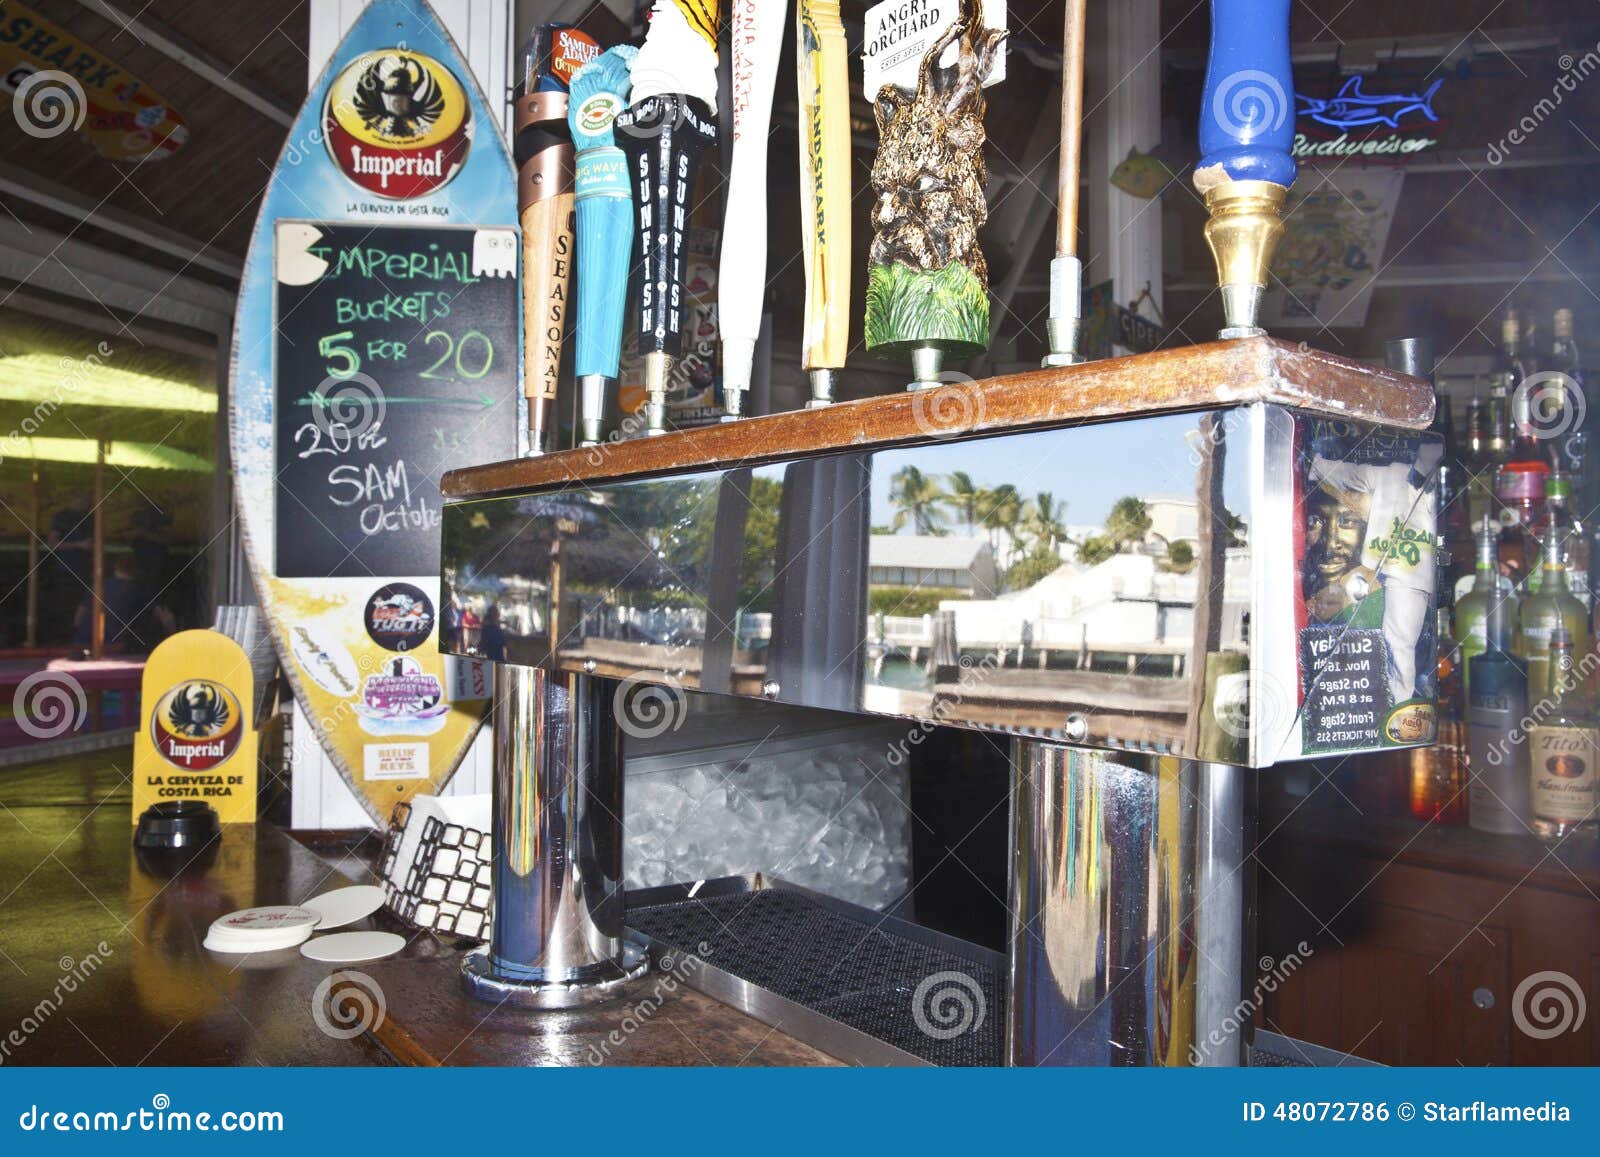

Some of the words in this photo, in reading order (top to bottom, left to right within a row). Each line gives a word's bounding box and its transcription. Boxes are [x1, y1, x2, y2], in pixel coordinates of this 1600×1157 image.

[869, 8, 940, 57] ORCHARD
[879, 0, 929, 34] ANGRY
[0, 8, 118, 90] SHARK
[559, 31, 599, 57] SAMUEL
[562, 46, 593, 65] ADAM
[351, 145, 442, 188] Imperial
[593, 160, 626, 174] WAVE
[346, 203, 358, 214] LA
[639, 152, 652, 333] SUNFISH
[669, 153, 688, 333] SUNFISH
[544, 234, 568, 395] SEASONAL
[318, 331, 361, 380] 5
[367, 339, 408, 361] FOR
[418, 330, 494, 382] 20
[328, 459, 412, 507] SAM
[169, 739, 225, 765] Imperial
[147, 776, 163, 786] LA
[167, 775, 223, 786] CERVEZA
[227, 775, 244, 785] DE
[158, 787, 199, 797] COSTA
[203, 787, 232, 797] RICA
